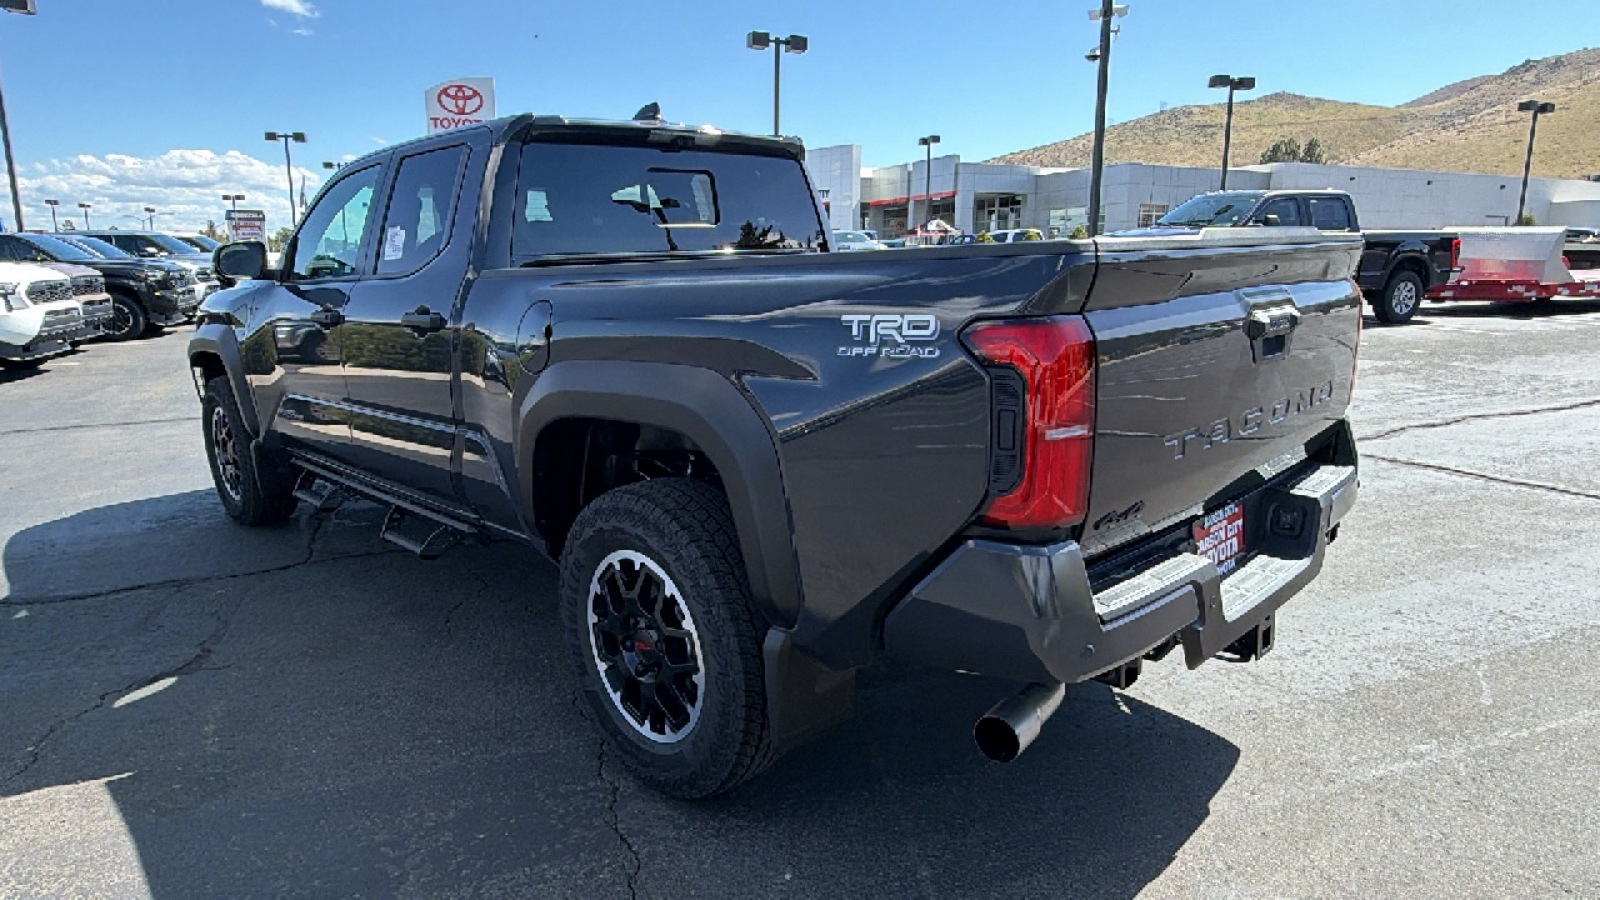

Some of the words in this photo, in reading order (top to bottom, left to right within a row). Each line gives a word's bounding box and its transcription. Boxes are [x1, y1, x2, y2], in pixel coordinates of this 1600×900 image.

[840, 314, 940, 347] TRD
[837, 346, 878, 357] OFF
[880, 344, 940, 358] ROAD
[1227, 518, 1243, 538] CITY
